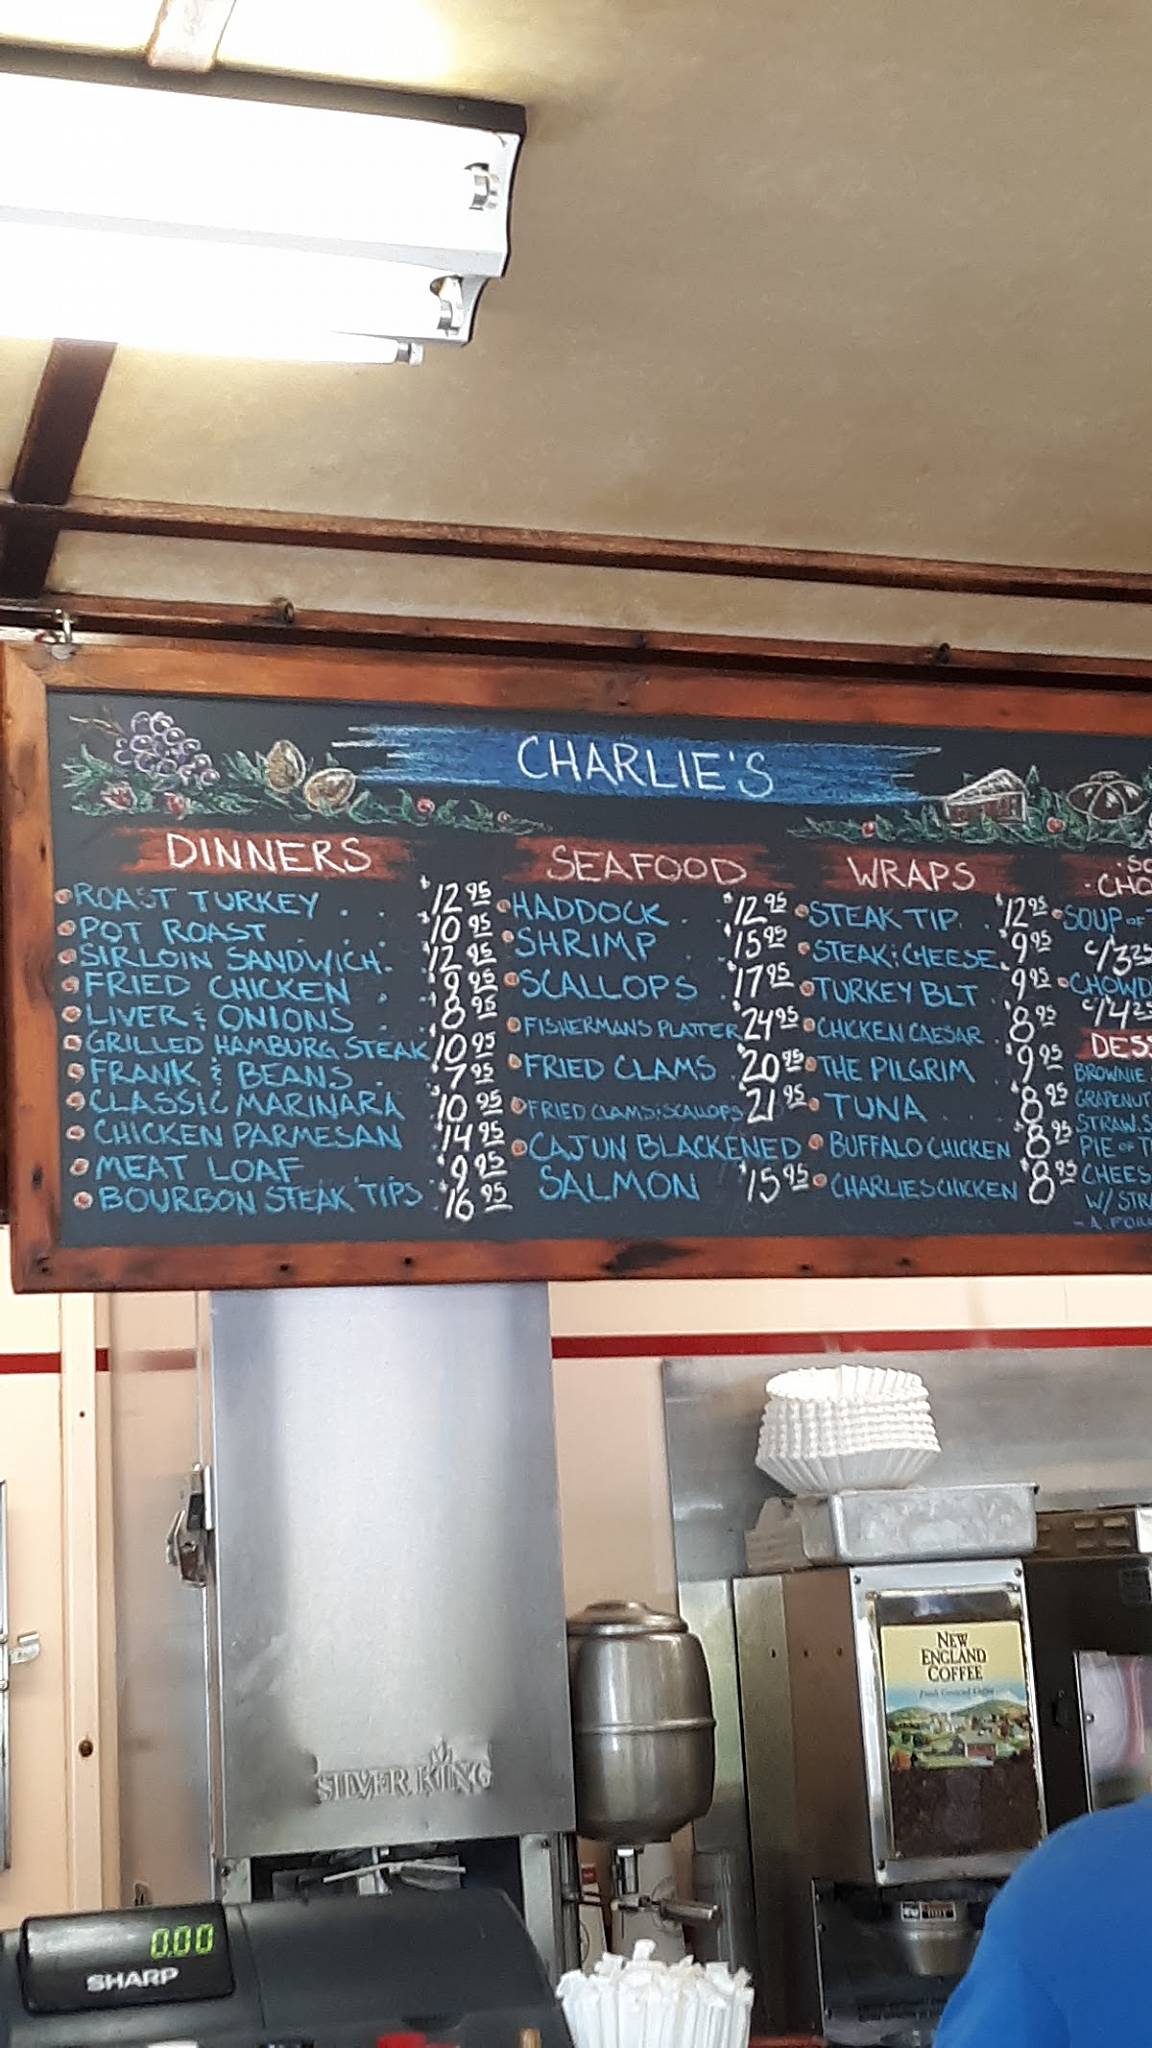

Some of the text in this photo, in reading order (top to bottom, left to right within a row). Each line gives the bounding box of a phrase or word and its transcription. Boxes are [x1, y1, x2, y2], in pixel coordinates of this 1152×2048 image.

[517, 735, 774, 798] CHARLIE'S
[167, 833, 372, 874] DINNERS
[546, 844, 747, 886] SEAFOOD
[848, 856, 976, 892] WRAPS
[74, 882, 177, 911] ROAST
[187, 890, 319, 920] TURKEY
[512, 891, 669, 926] HADDOCK
[808, 901, 902, 928] STEAK
[903, 907, 960, 931] TIP
[80, 916, 142, 945] POT
[163, 919, 267, 945] ROAST
[1063, 904, 1122, 933] SOUP
[80, 943, 212, 971] SIRLOIN
[514, 926, 656, 962] SHRIMP
[85, 971, 191, 998] FRIED
[208, 975, 351, 1004] CHICKEN
[519, 969, 698, 1001] SCALLOPS
[812, 976, 912, 1004] TURKEY
[920, 980, 978, 1007] BLT
[86, 1004, 187, 1029] LIVER
[217, 1005, 355, 1032] ONIONS
[523, 1015, 651, 1038] FISHERMANS
[658, 1019, 743, 1042] PLATTER
[817, 1016, 904, 1043] CHICKEN
[909, 1021, 985, 1046] CAESAR
[86, 1032, 203, 1057] GRILLED
[215, 1032, 340, 1060] HAMBURG
[344, 1037, 431, 1062] STEAK
[91, 1061, 201, 1086] FRANK
[238, 1062, 354, 1090] BEANS
[523, 1054, 605, 1080] FRIED
[614, 1054, 716, 1082] CLAMS
[818, 1054, 862, 1081] THE
[871, 1056, 976, 1083] PILGRIM
[1074, 1062, 1146, 1083] BROWNIE
[89, 1090, 227, 1116] CLASSIC
[236, 1093, 405, 1118] MARINARA
[528, 1099, 586, 1120] FRIED
[824, 1092, 928, 1122] TUNA
[94, 1120, 223, 1148] CHICKEN
[233, 1123, 403, 1151] PARMESAN
[528, 1131, 802, 1162] CAJUN BLACKENED
[830, 1130, 923, 1159] BUFFALO
[927, 1136, 1012, 1160] CHICKEN
[1080, 1134, 1116, 1158] PIE
[95, 1154, 188, 1182] MEAT
[207, 1156, 305, 1182] LOAF
[539, 1164, 700, 1202] SALMON
[100, 1186, 257, 1215] BOURBON
[265, 1187, 356, 1215] STEAK
[358, 1180, 424, 1207] TIPS
[921, 1648, 987, 1666] ENGLAND
[927, 1665, 983, 1682] COFFEE
[318, 1761, 492, 1800] SILVER KING
[151, 1924, 213, 1960] 0.00
[86, 1967, 179, 1992] SHARP
